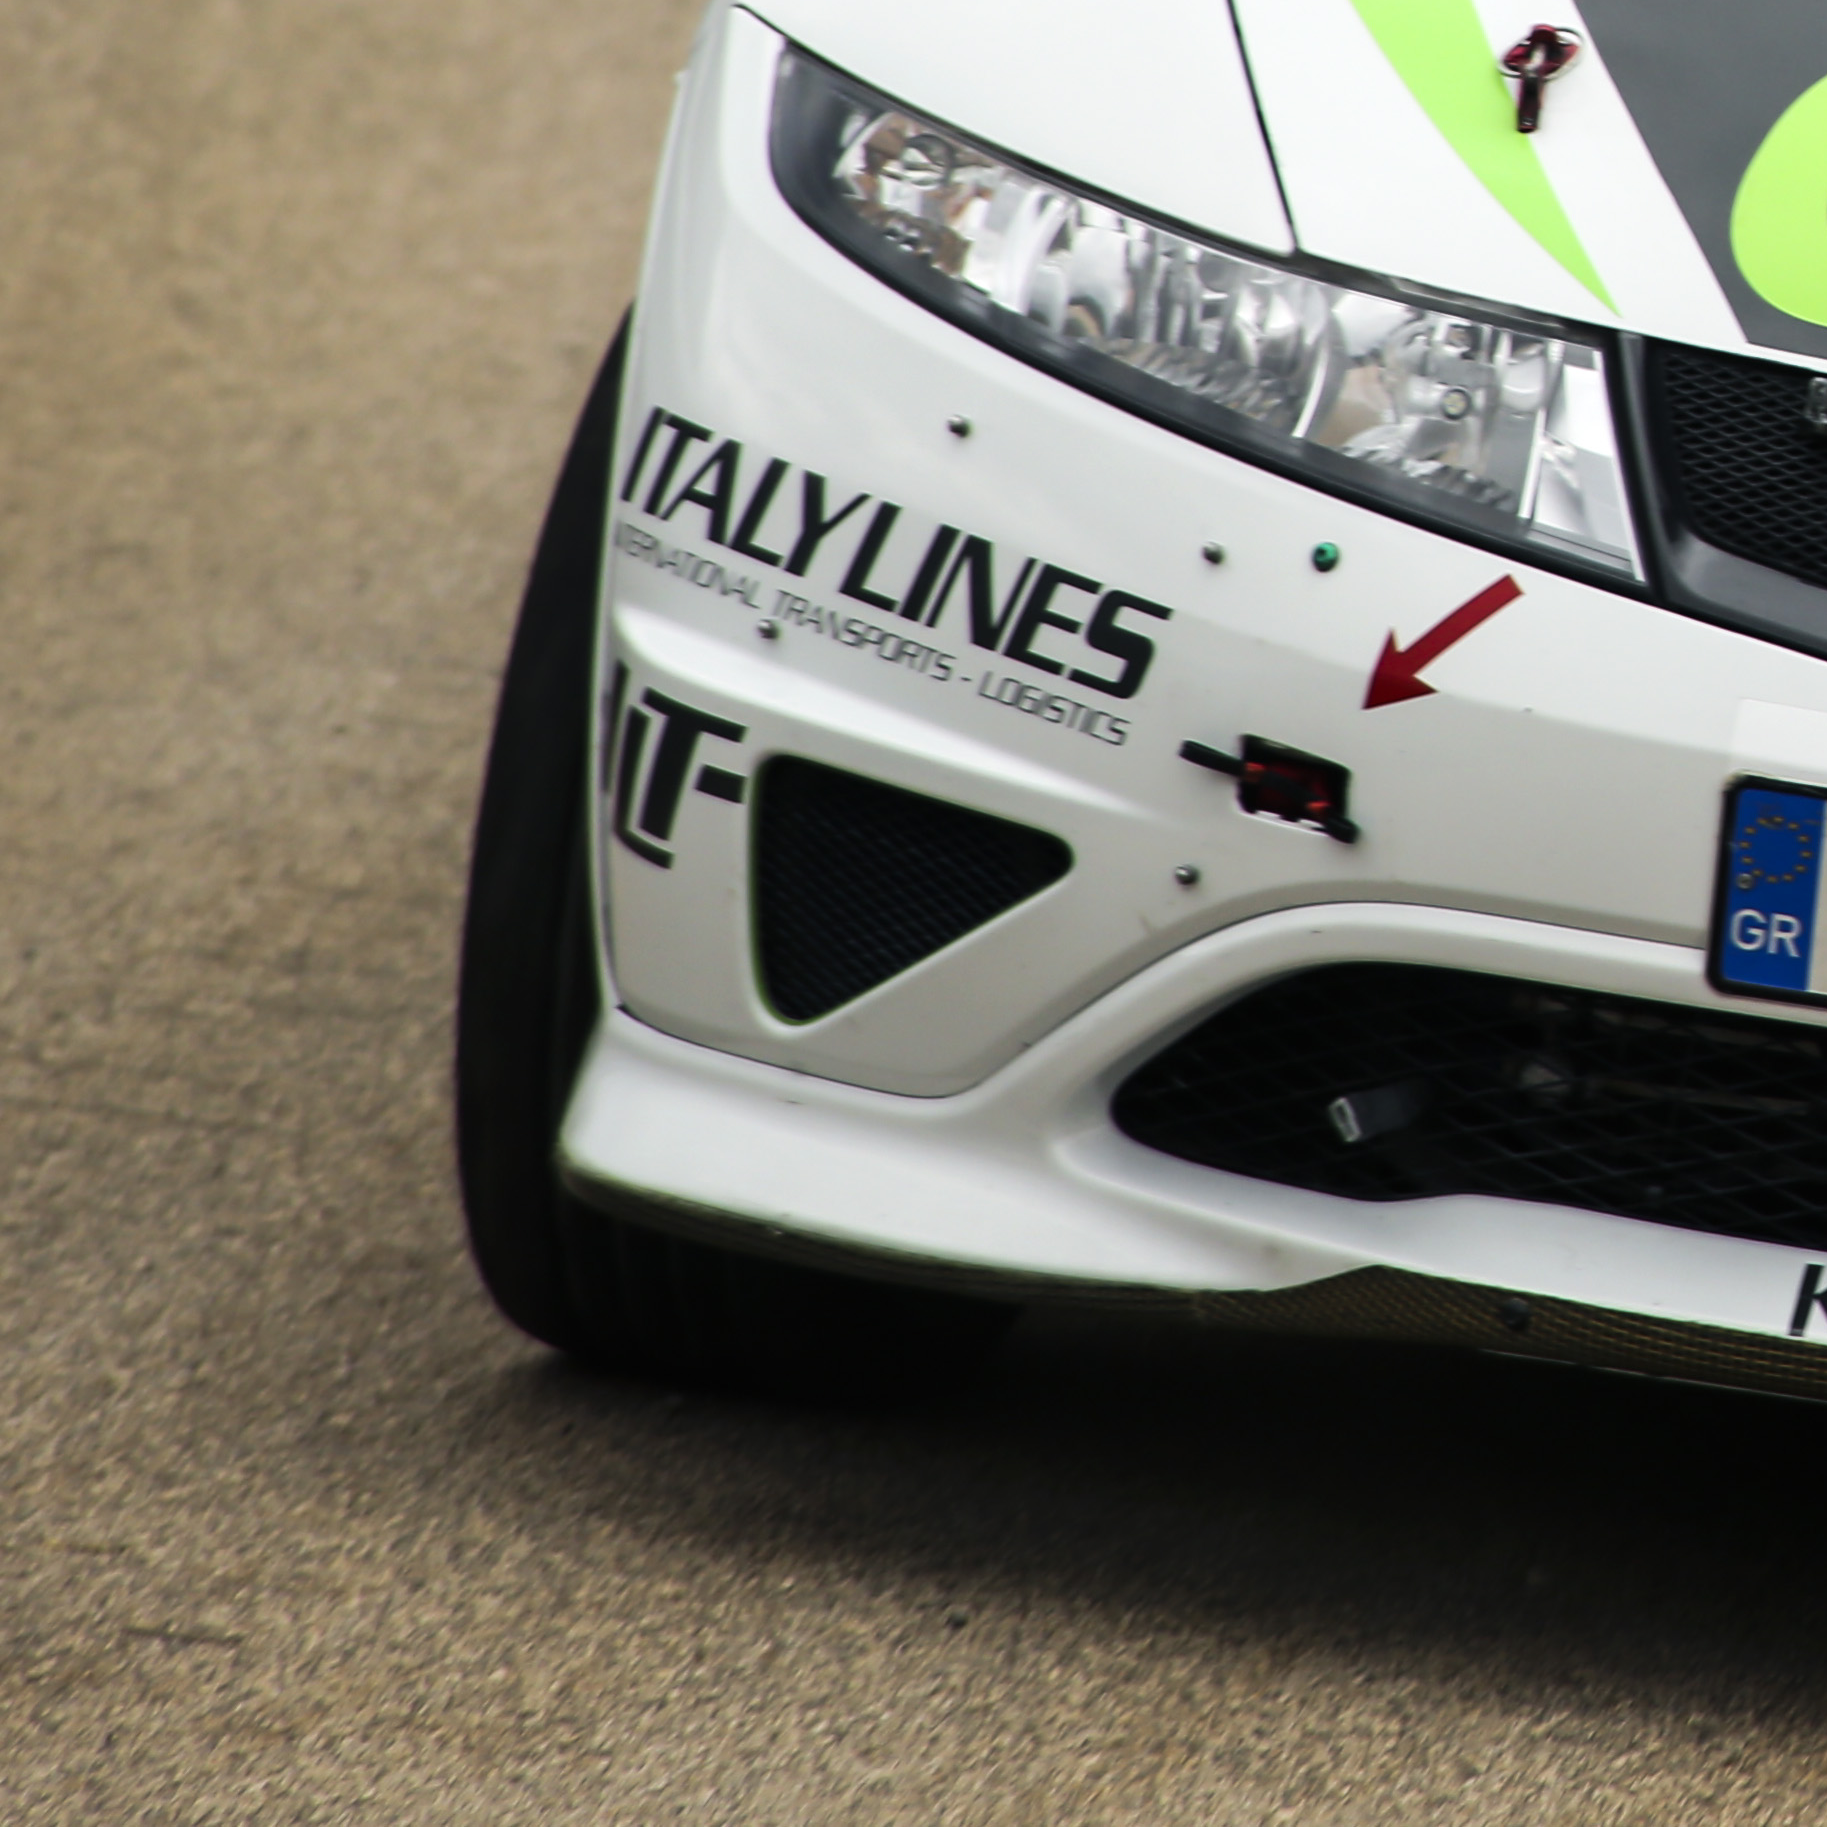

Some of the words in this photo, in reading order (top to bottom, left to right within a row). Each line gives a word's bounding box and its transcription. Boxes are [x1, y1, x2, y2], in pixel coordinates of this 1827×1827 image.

[621, 405, 1175, 700] ITALYLINES
[772, 587, 957, 683] TRANSPORTS
[978, 669, 1131, 747] LOGISTICS
[1730, 908, 1802, 958] GR
